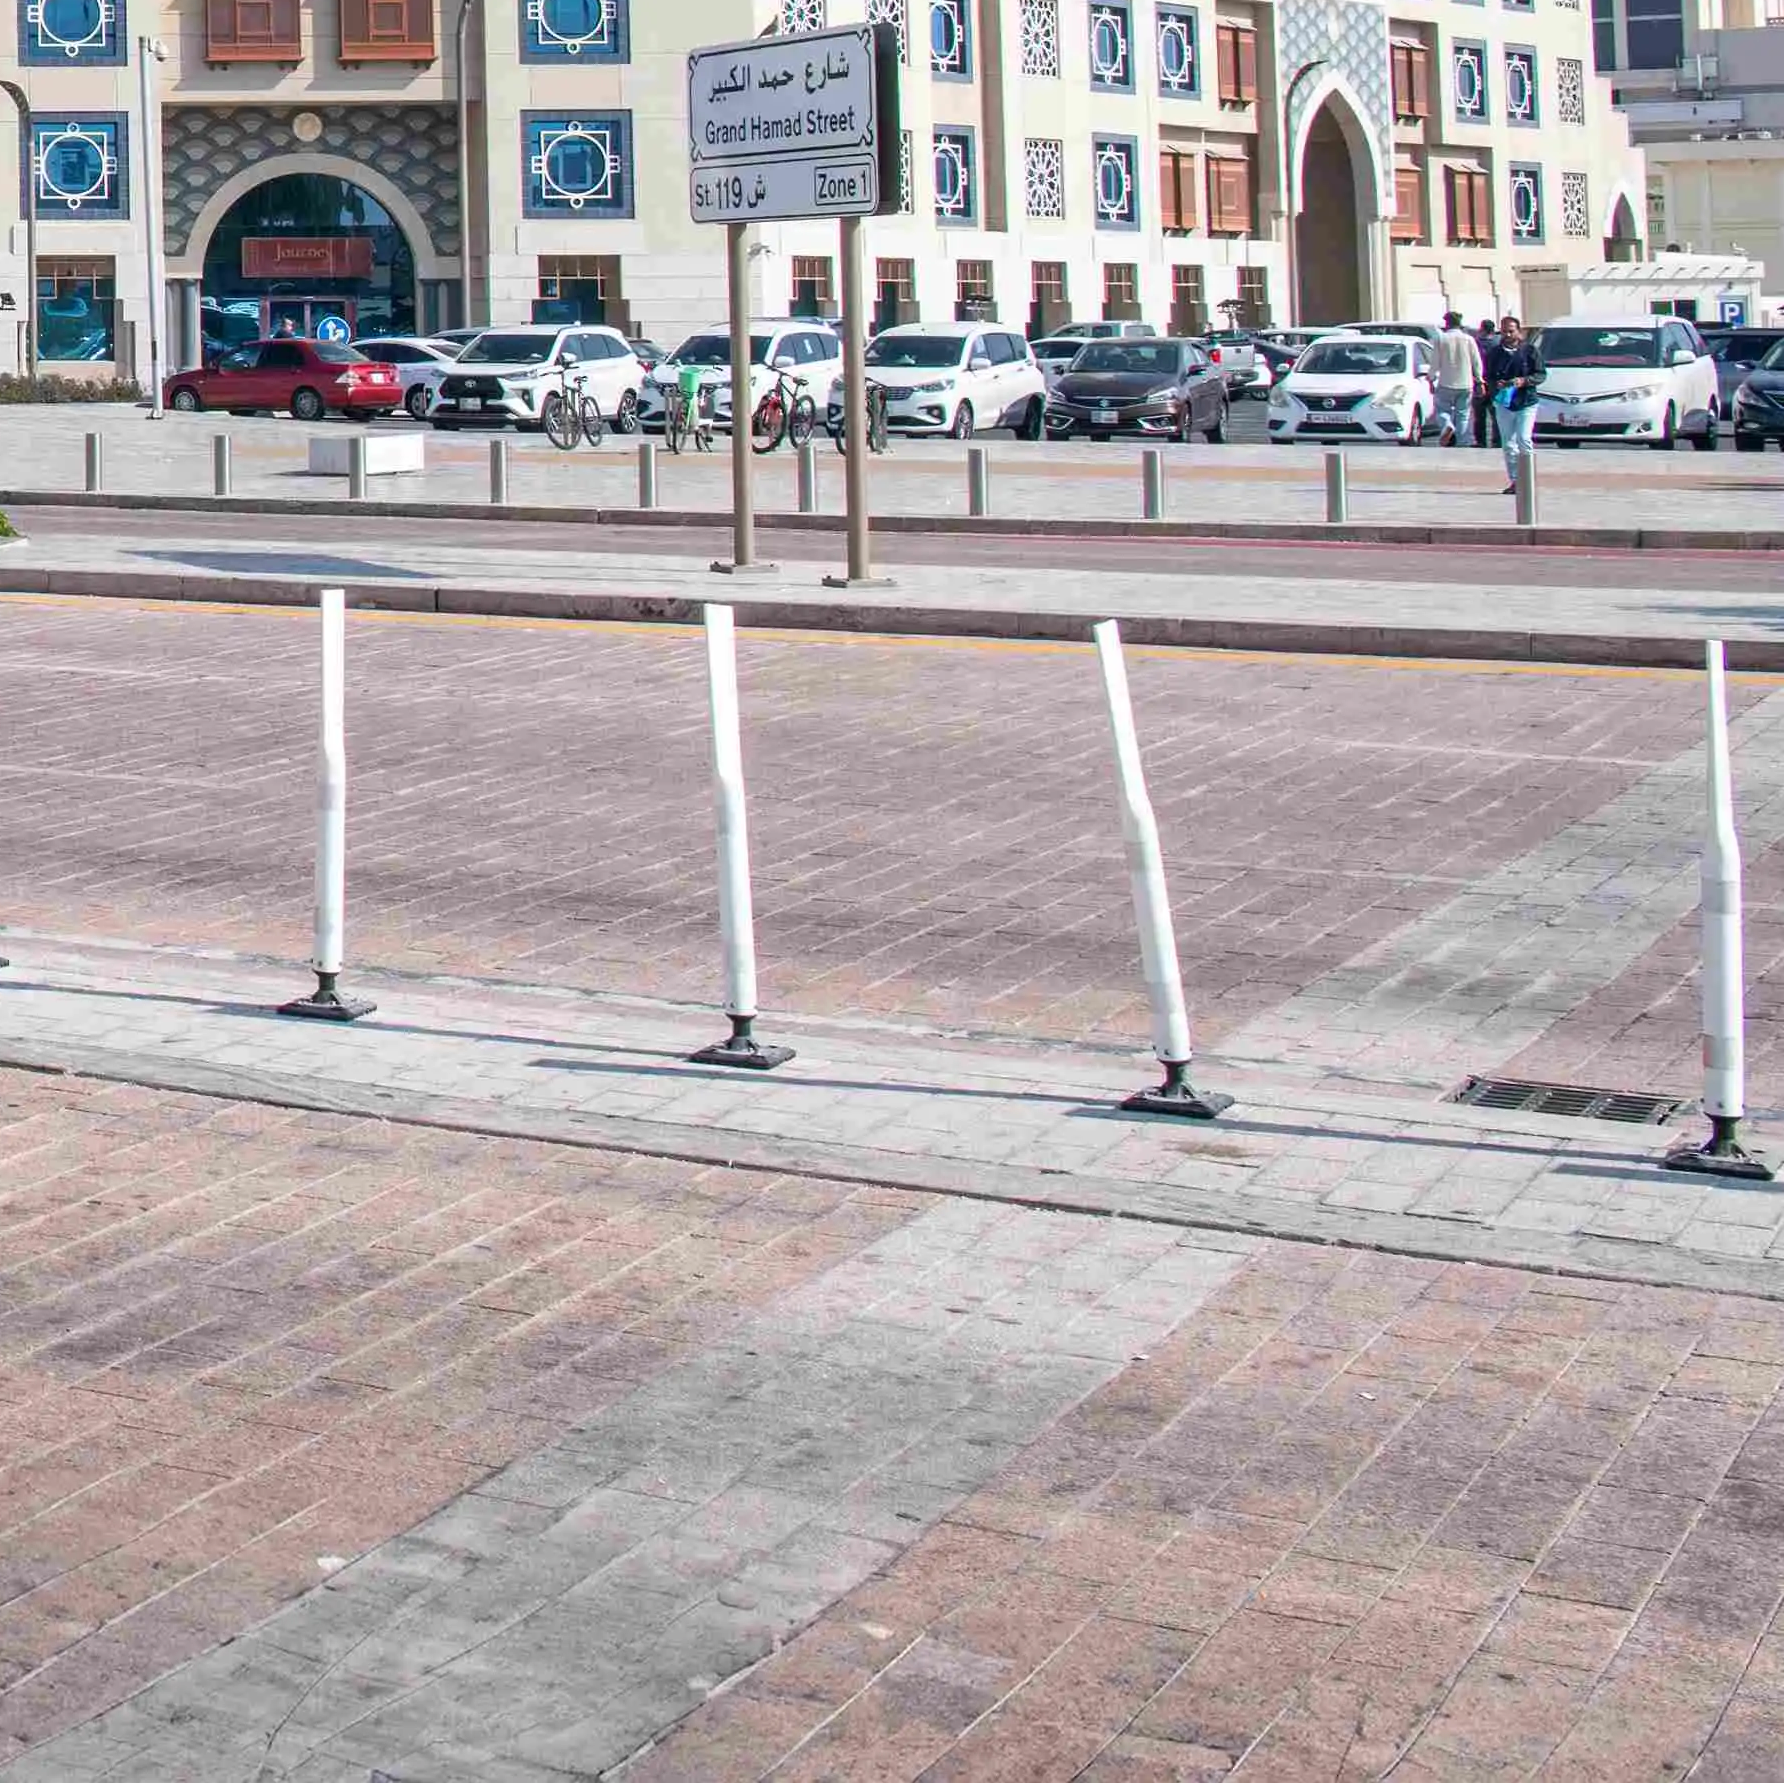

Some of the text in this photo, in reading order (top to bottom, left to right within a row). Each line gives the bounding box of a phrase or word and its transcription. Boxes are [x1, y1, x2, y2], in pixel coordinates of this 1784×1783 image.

[708, 51, 850, 103] شارع حمد الكبير
[705, 105, 856, 145] Grand Hamad Street
[716, 175, 743, 210] 119
[747, 174, 766, 209] ش
[817, 170, 868, 200] Zone 1
[1724, 303, 1740, 324] P
